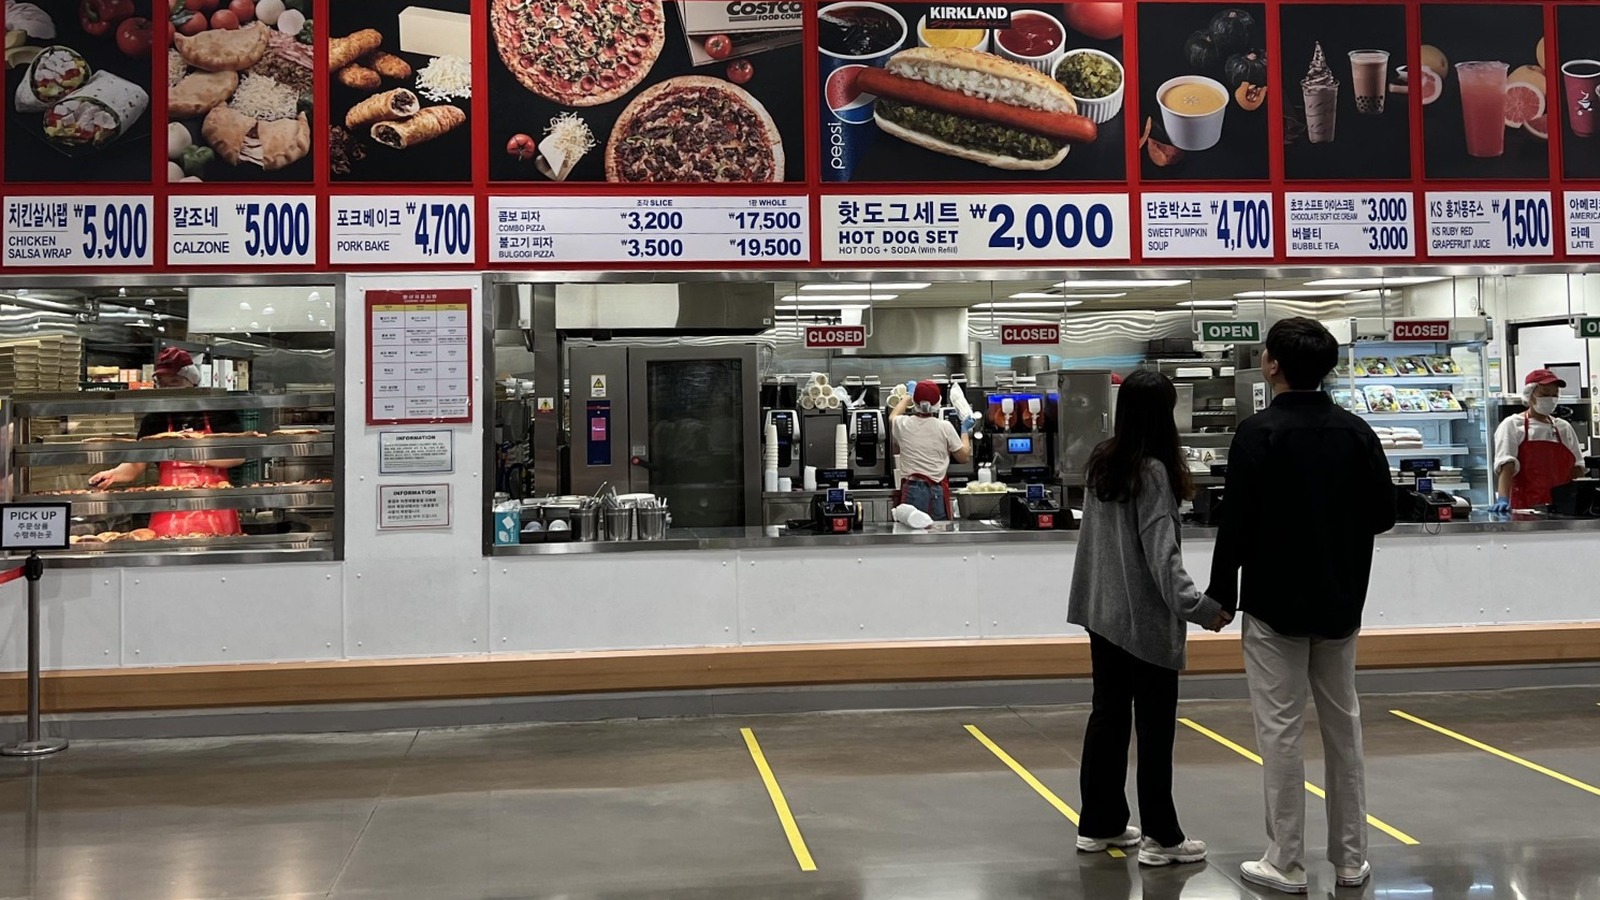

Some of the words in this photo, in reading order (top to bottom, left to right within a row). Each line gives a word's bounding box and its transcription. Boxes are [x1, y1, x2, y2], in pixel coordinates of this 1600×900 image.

[727, 1, 802, 15] COSTCO
[930, 6, 1008, 19] KIRKLAND
[827, 122, 846, 170] pepsi
[650, 199, 673, 207] SLICE
[1290, 199, 1303, 211] 초코
[1304, 199, 1323, 211] 소프트
[1324, 199, 1354, 211] 아이스크림
[1430, 201, 1442, 217] KS
[1446, 200, 1484, 218] 홍자몽주스
[1570, 198, 1600, 211] 아메리
[8, 203, 68, 228] 치킨살사랩
[498, 211, 518, 222] 콤보
[521, 211, 540, 222] 피자
[838, 201, 960, 225] 핫도그세트
[1147, 201, 1202, 220] 단호박스프
[173, 206, 218, 228] 칼조네
[337, 208, 401, 227] 포크베이크
[498, 224, 523, 232] COMBO
[524, 224, 546, 232] PIZZA
[1147, 228, 1173, 237] SWEET
[1174, 228, 1208, 238] PUMPKIN
[1291, 227, 1321, 240] 버블티
[1432, 227, 1441, 236] KS
[1442, 227, 1459, 236] RUBY
[1460, 227, 1473, 236] RED
[8, 236, 56, 247] CHICKEN
[499, 237, 530, 248] 불고기
[533, 237, 553, 248] 피자
[838, 231, 875, 244] HOT
[882, 231, 920, 244] DOG
[925, 231, 959, 244] SET
[173, 242, 230, 254] CALZONE
[337, 241, 363, 251] PORK
[364, 241, 390, 251] BAKE
[1148, 241, 1169, 250] SOUP
[1432, 239, 1471, 249] GRAPEFRUIT
[1472, 239, 1490, 249] JUICE
[1571, 241, 1594, 249] LATTE
[8, 249, 41, 259] SALSA
[43, 249, 72, 259] WRAP
[918, 246, 936, 255] (With
[938, 246, 958, 254] Refill)
[1209, 325, 1253, 338] OPEN
[1395, 325, 1447, 337] CLOSED
[1586, 321, 1600, 333] O
[808, 330, 863, 343] CLOSED
[1003, 328, 1057, 341] CLOSED
[10, 511, 38, 520] PICK
[41, 511, 57, 520] UP
[18, 522, 48, 530] 주문상품
